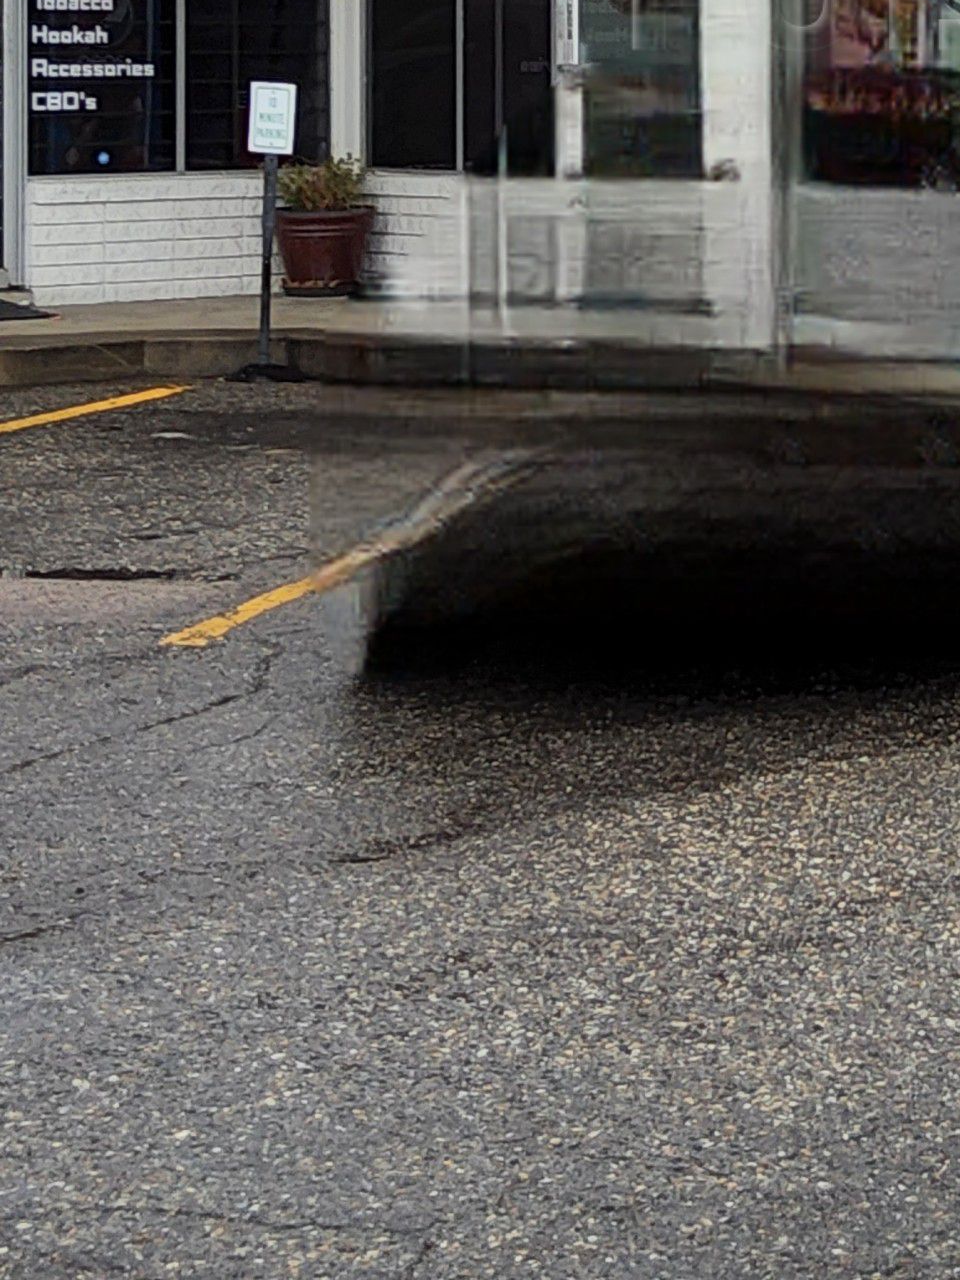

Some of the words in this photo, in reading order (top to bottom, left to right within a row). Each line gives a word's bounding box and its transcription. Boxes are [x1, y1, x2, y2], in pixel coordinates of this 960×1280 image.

[31, 24, 109, 45] Hookah
[31, 57, 155, 78] Accessories
[31, 91, 98, 111] CBD's
